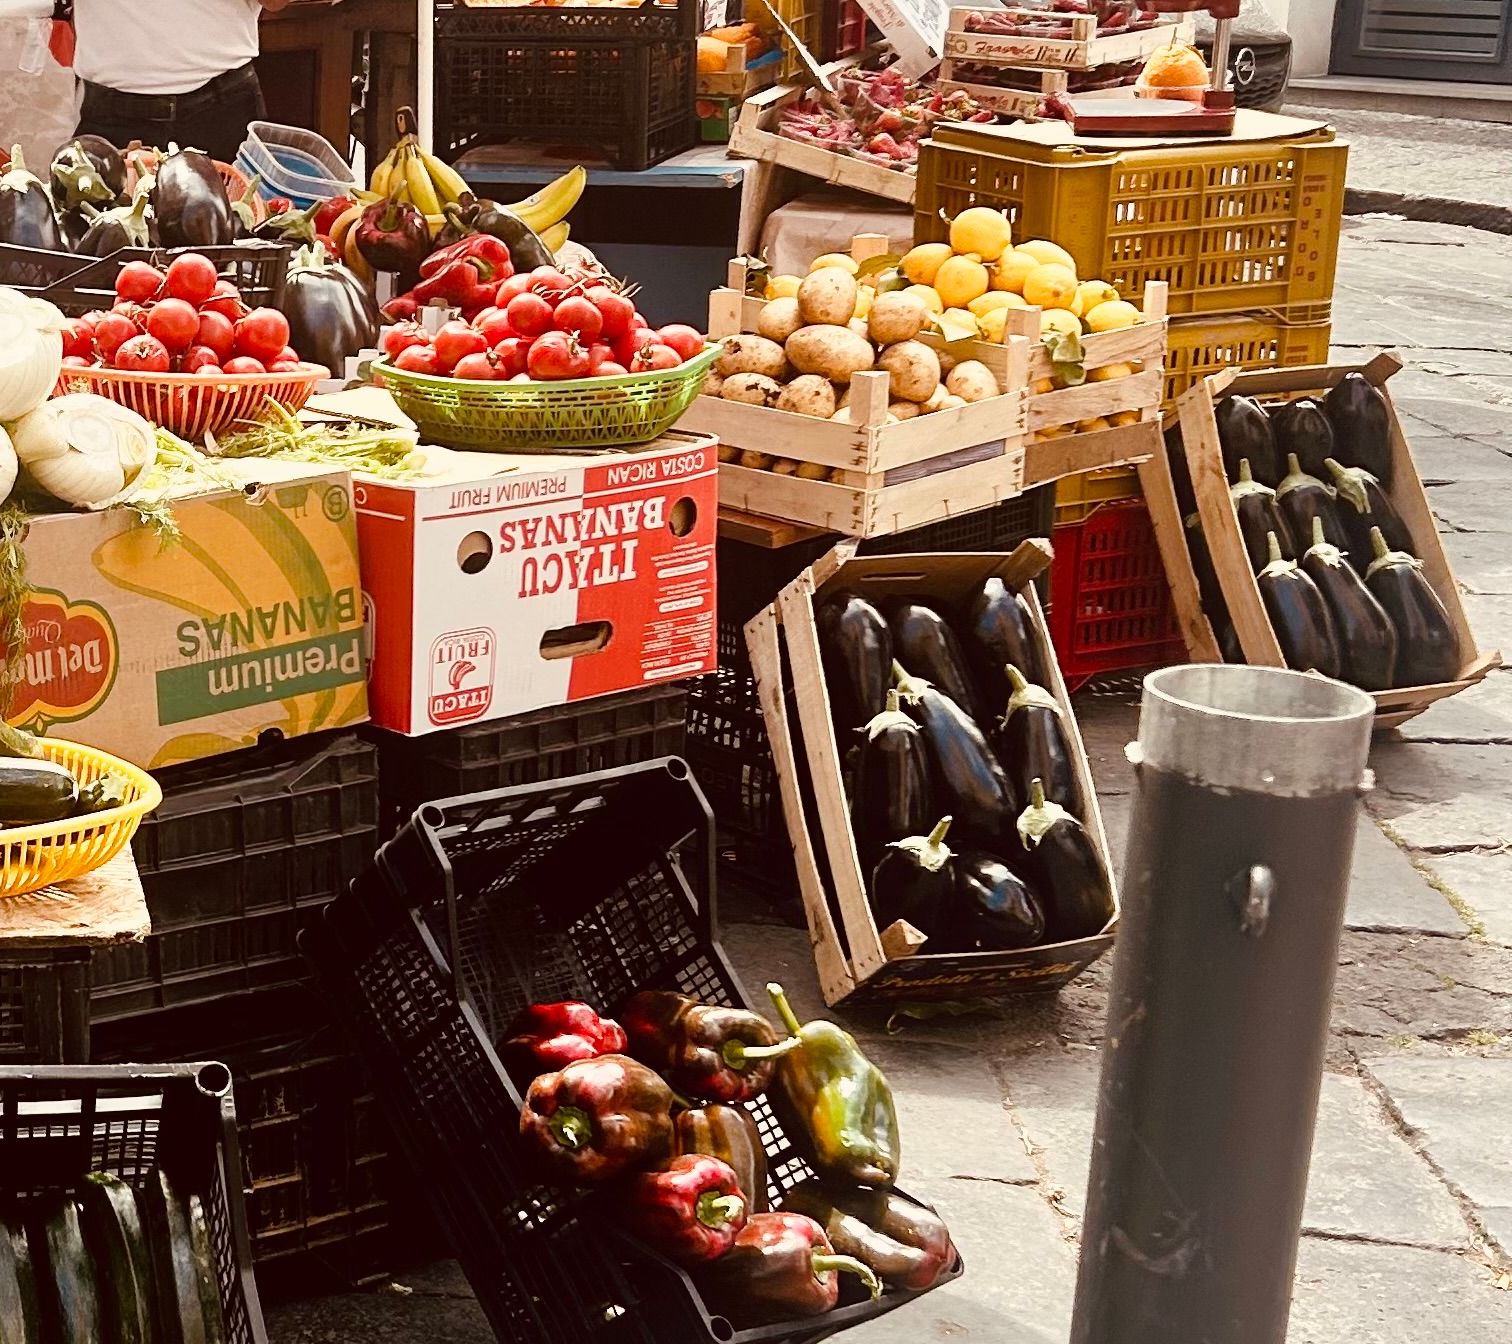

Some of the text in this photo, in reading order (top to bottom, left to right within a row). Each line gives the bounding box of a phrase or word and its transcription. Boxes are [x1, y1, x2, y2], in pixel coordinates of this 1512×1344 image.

[607, 453, 705, 487] COSTA RICAN
[448, 475, 567, 509] PREMIUM FRUIT
[500, 495, 667, 553] BANANAS
[518, 540, 639, 599] ITACU
[176, 587, 356, 656] BANANAS
[58, 639, 103, 678] Del
[208, 638, 361, 696] Premium
[435, 639, 490, 664] FRUIT
[432, 689, 488, 714] ITACU
